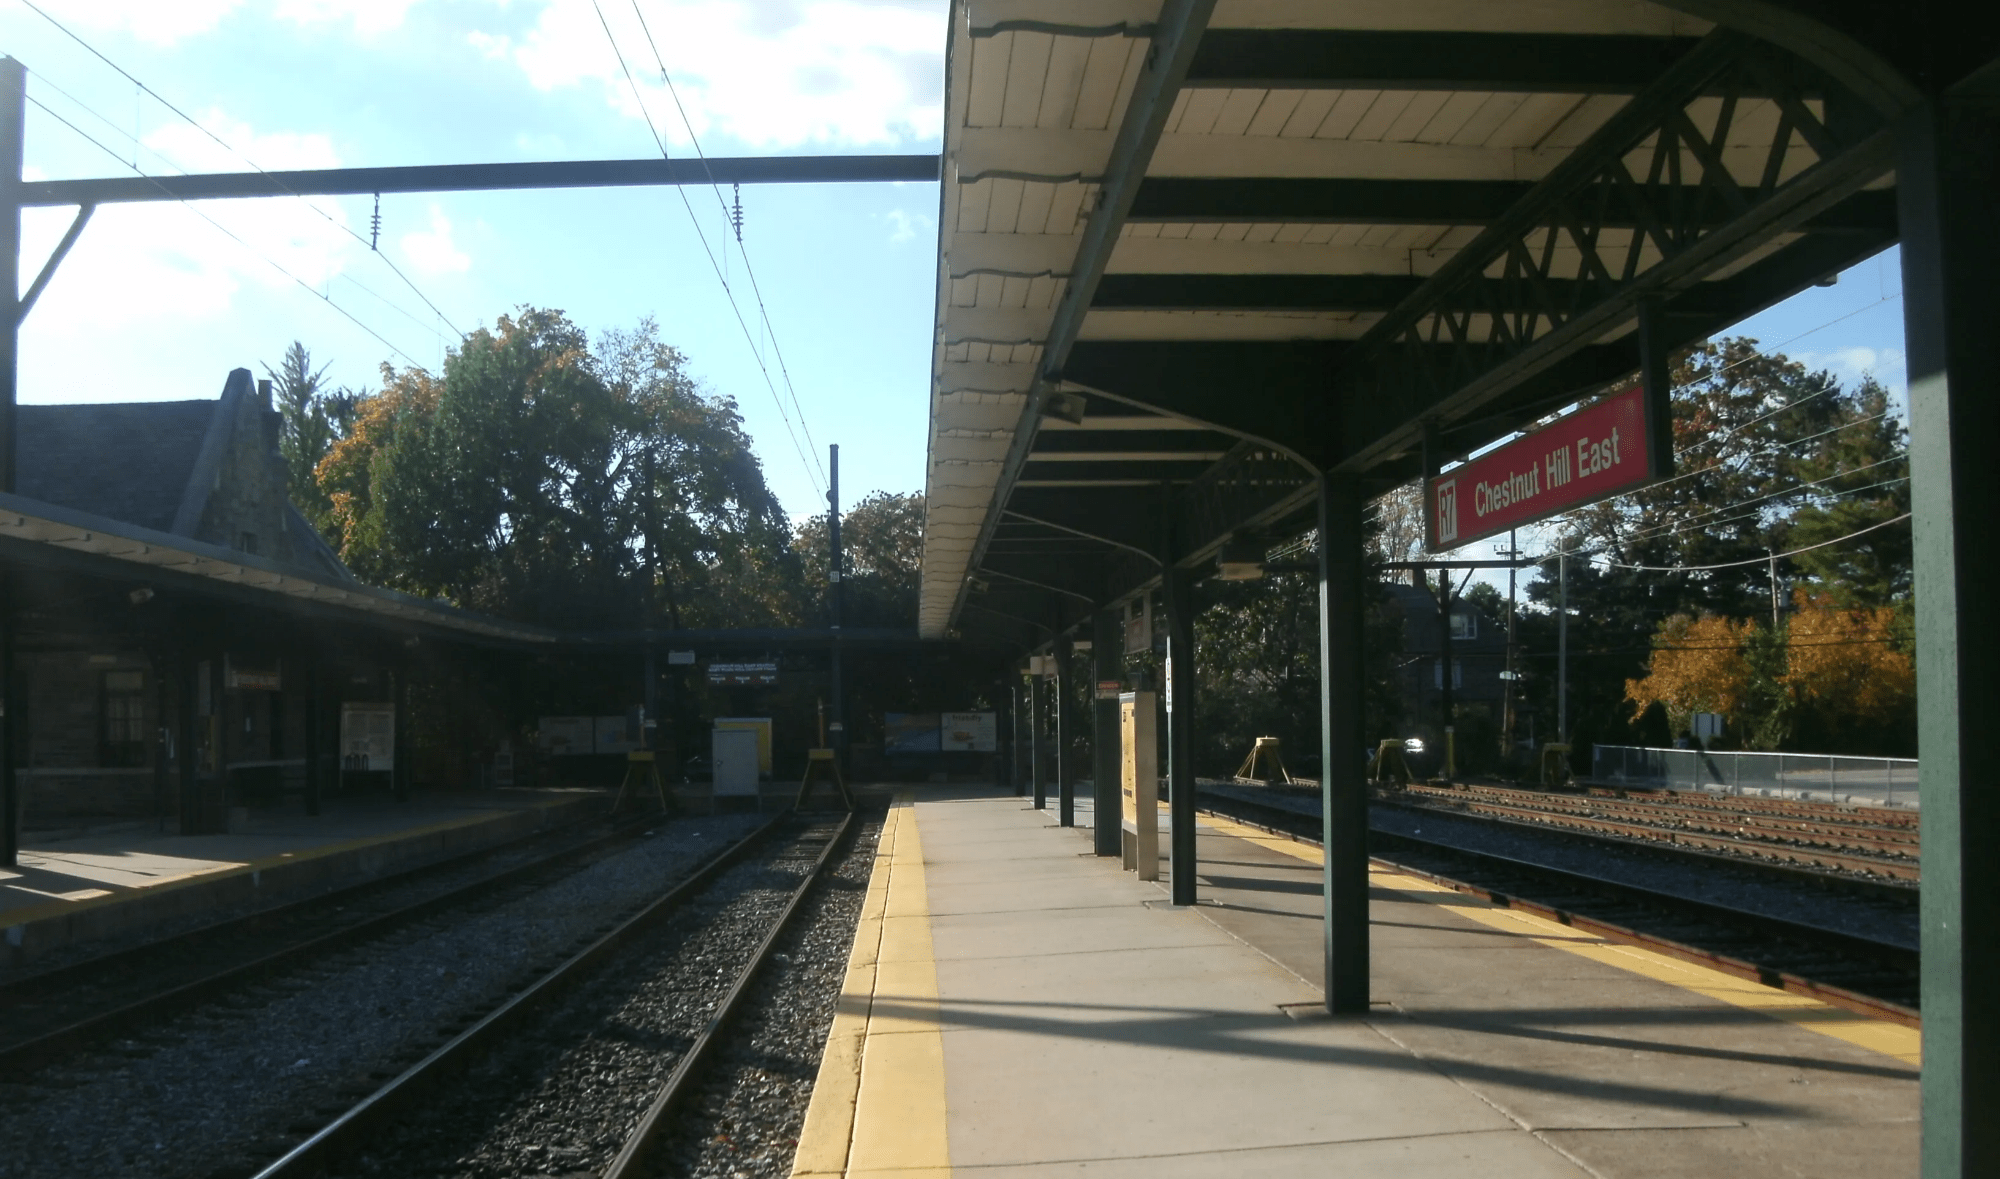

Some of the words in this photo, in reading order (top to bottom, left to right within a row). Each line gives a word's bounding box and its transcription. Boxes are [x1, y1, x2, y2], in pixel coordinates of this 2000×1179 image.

[1439, 485, 1454, 538] R7
[1475, 461, 1540, 517] Chestnut
[1545, 445, 1571, 490] Hill
[1577, 427, 1620, 478] East
